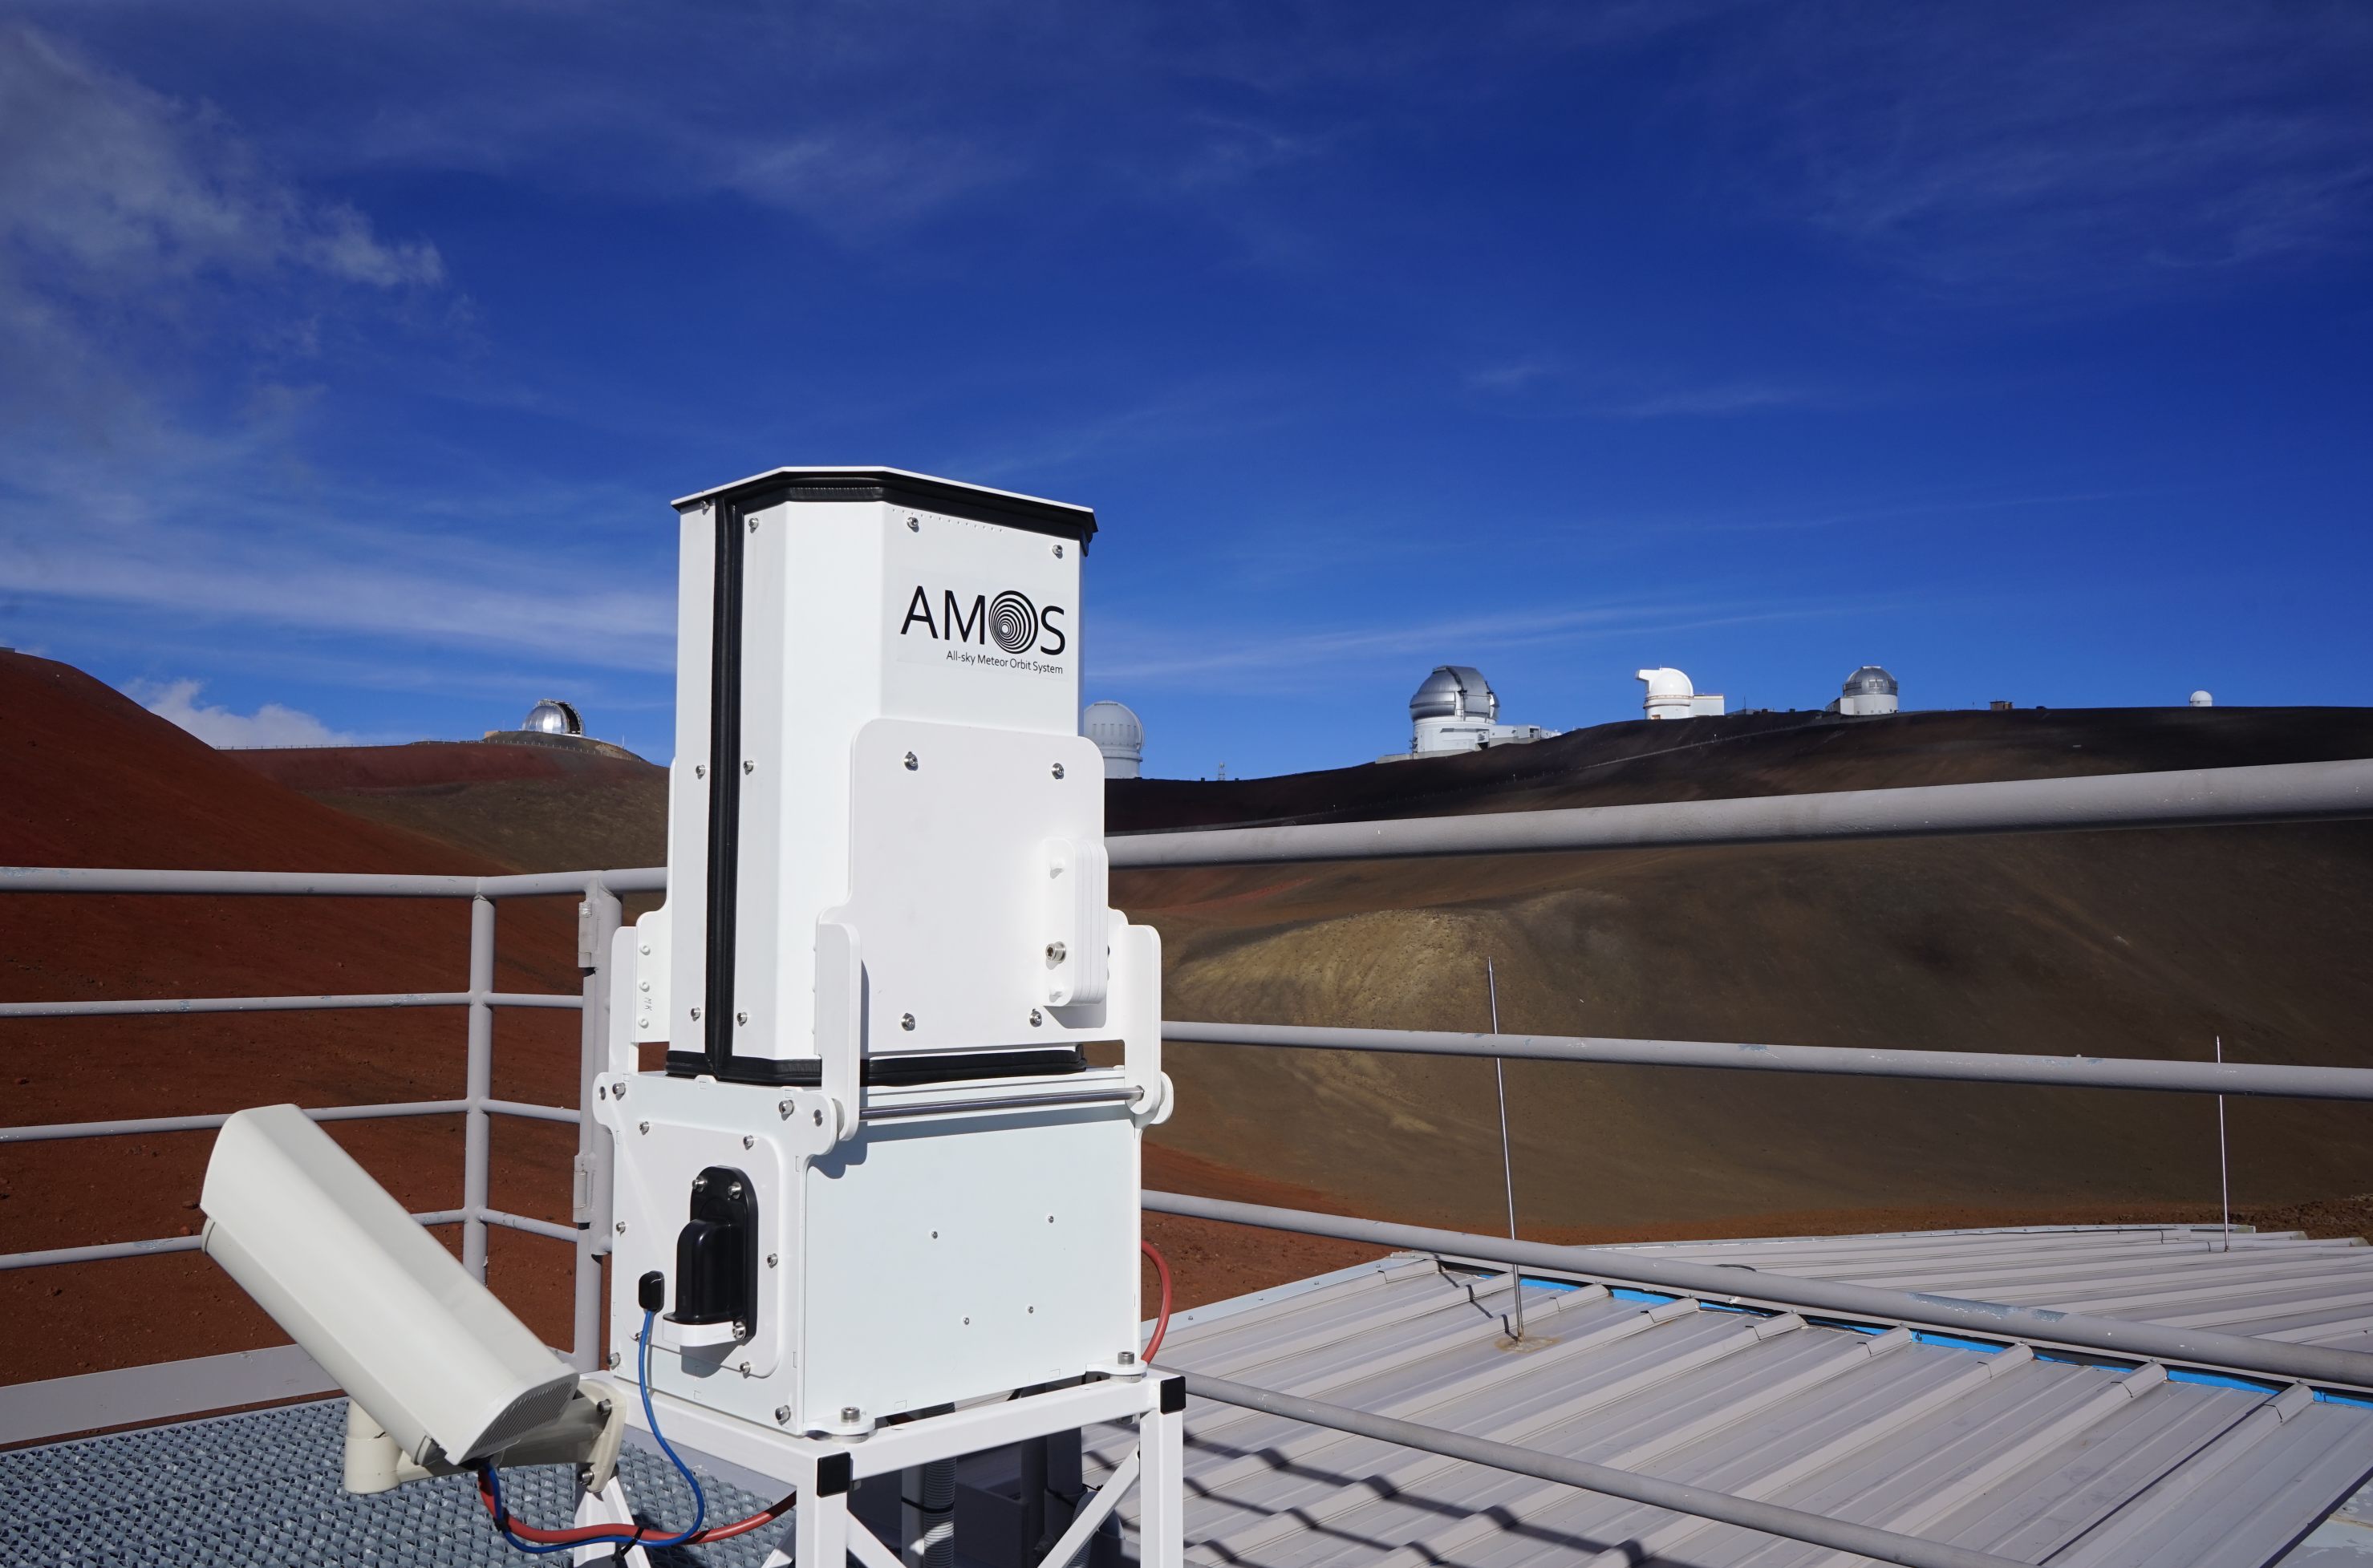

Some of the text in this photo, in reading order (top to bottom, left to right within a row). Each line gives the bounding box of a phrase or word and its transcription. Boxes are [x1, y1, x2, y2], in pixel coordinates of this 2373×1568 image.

[900, 585, 1066, 656] AMOS
[946, 650, 1063, 675] All-sky Meteor Orbit System
